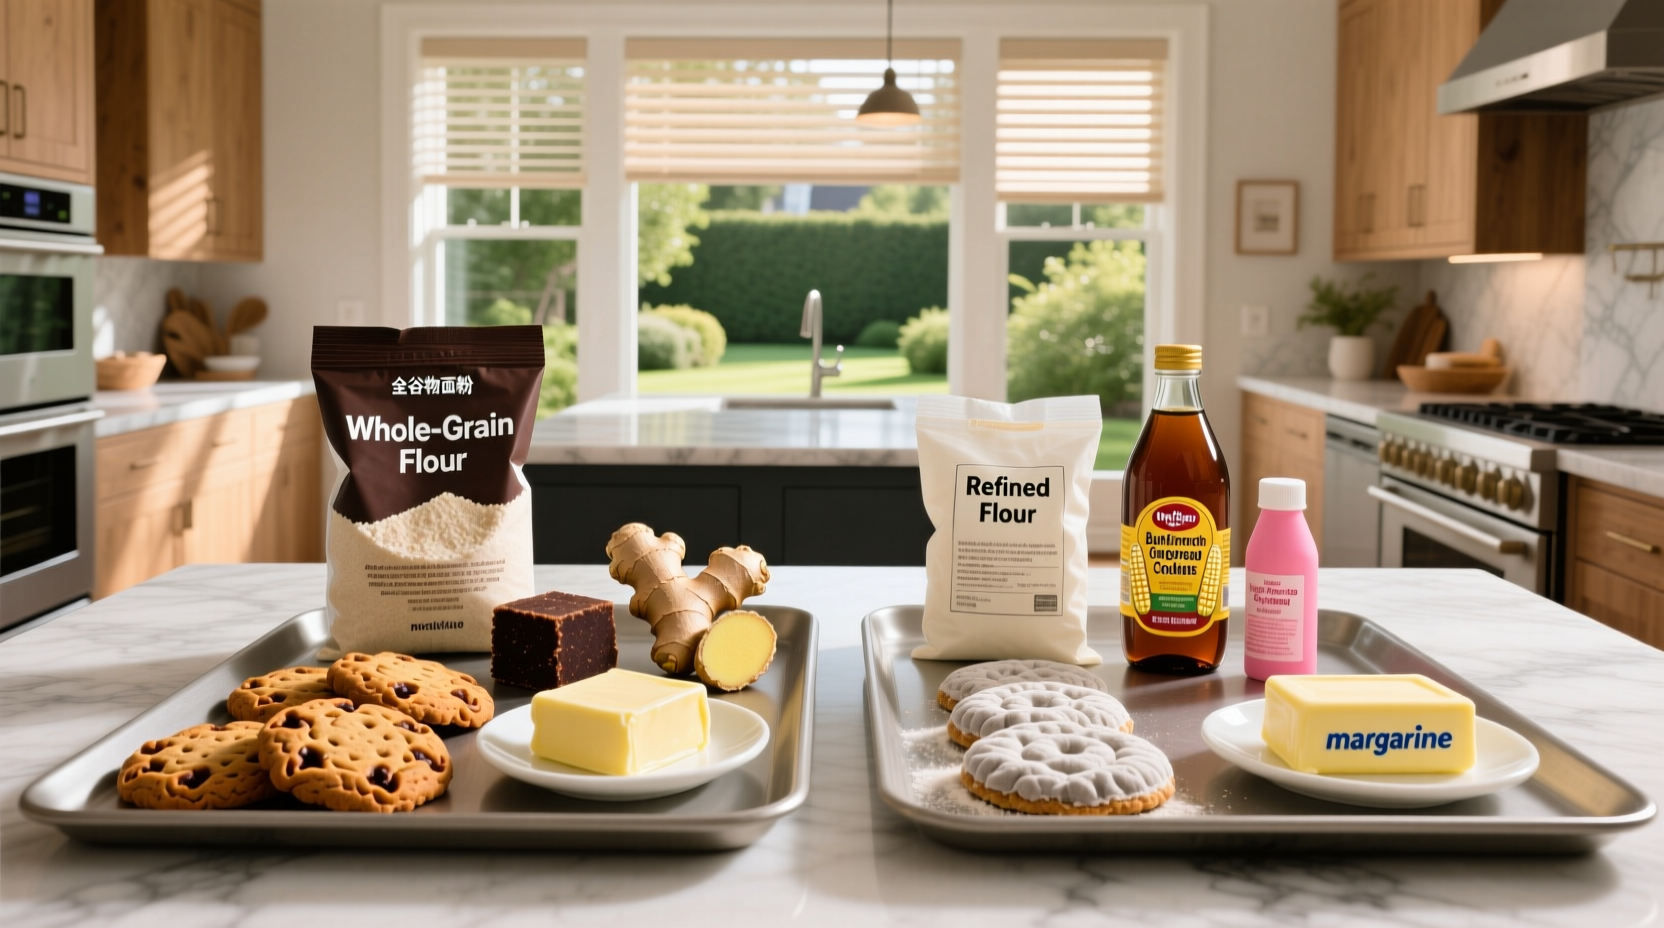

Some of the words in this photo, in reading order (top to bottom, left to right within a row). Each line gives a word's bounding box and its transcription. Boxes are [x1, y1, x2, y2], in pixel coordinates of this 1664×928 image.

[345, 412, 514, 442] Whole-Grain
[399, 448, 468, 474] Flour
[966, 475, 1050, 497] Refined
[979, 502, 1037, 523] Flour
[1326, 724, 1453, 756] margarine
